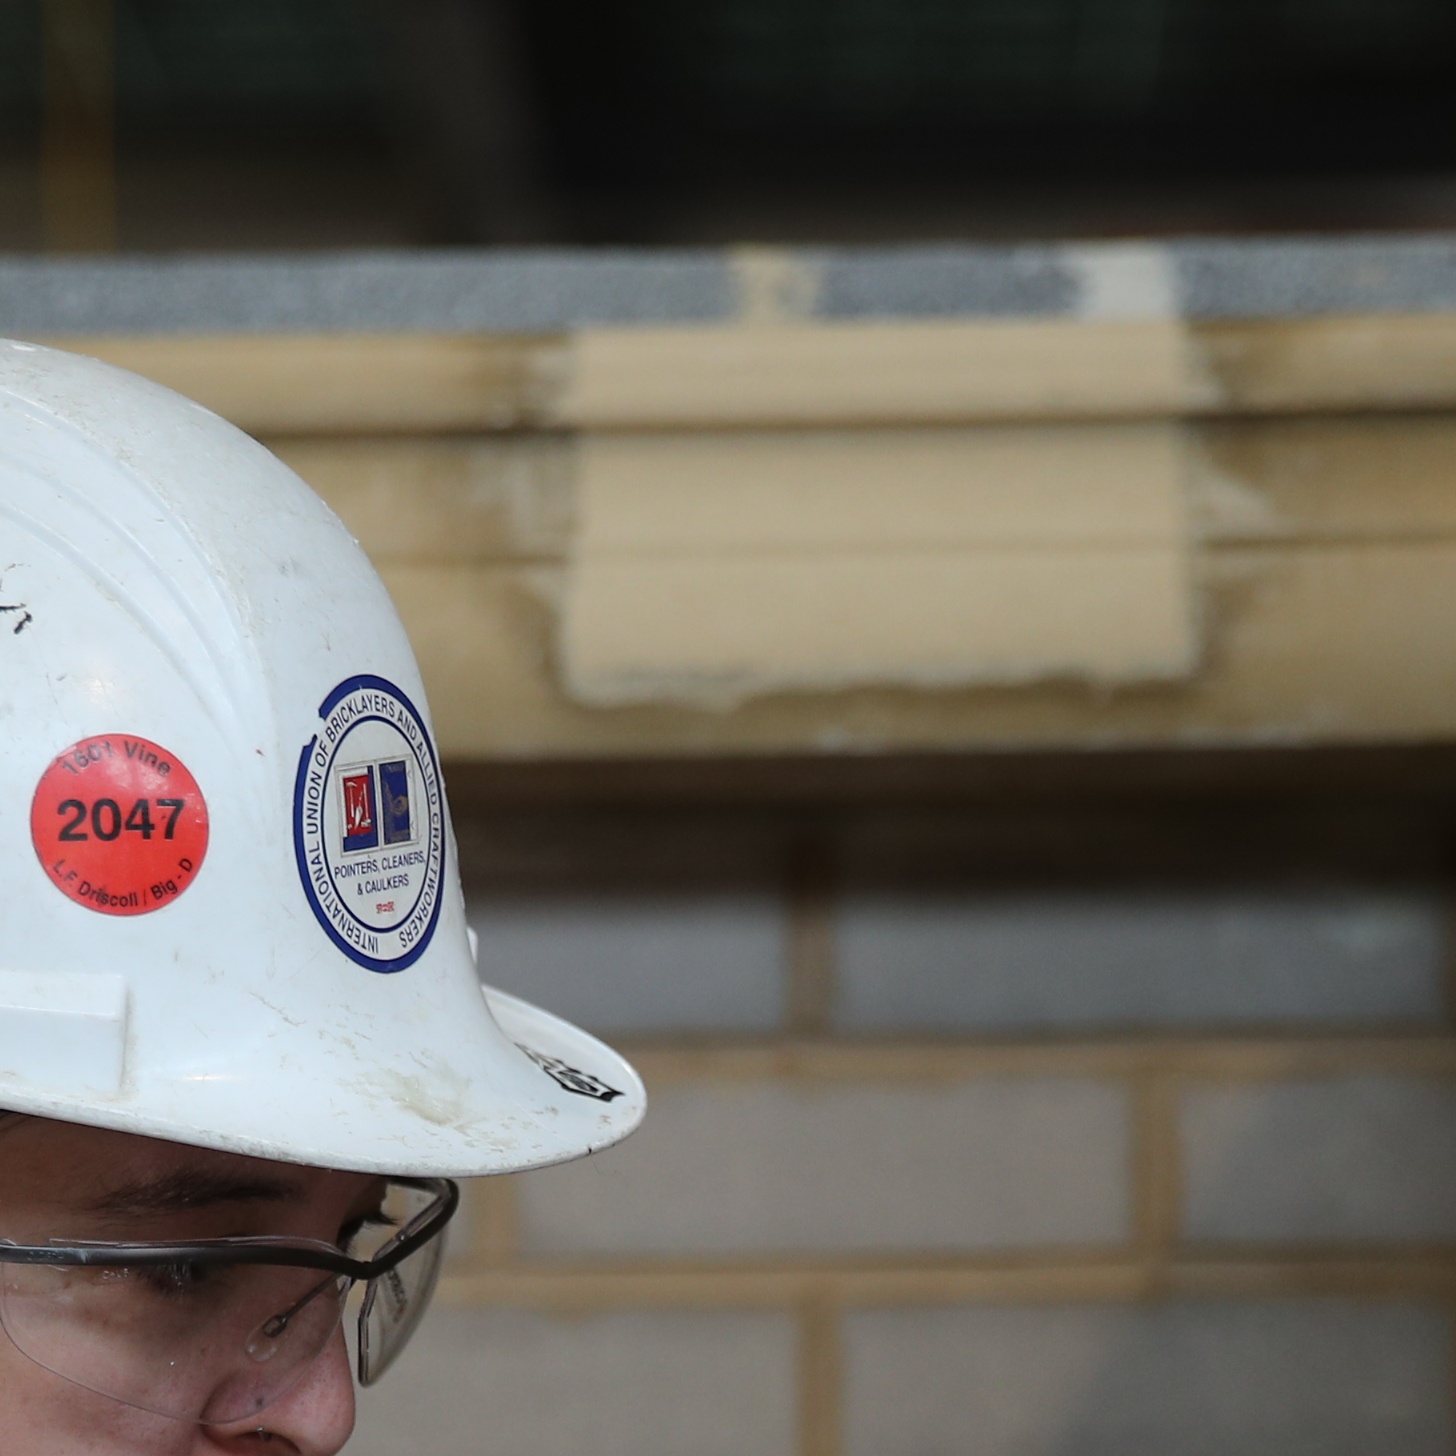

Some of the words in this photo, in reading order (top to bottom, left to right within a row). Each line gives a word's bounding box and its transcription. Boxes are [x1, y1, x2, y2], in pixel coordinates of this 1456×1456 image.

[325, 694, 395, 743] BRICKLAYERS
[397, 709, 418, 741] AND
[62, 740, 112, 775] 1601
[123, 740, 171, 777] Vine
[314, 740, 329, 768] OF
[416, 742, 438, 806] ALLIED
[57, 797, 186, 842] 2047
[306, 770, 323, 835] UNION
[334, 859, 381, 880] POINTERS,
[381, 850, 426, 872] CLEANERS,
[365, 873, 410, 894] CAULKERS
[398, 811, 441, 949] CRAFTWORKERS
[78, 880, 138, 908] Driscoll
[150, 880, 178, 901] Big
[307, 841, 379, 955] INTERNATIONAL
